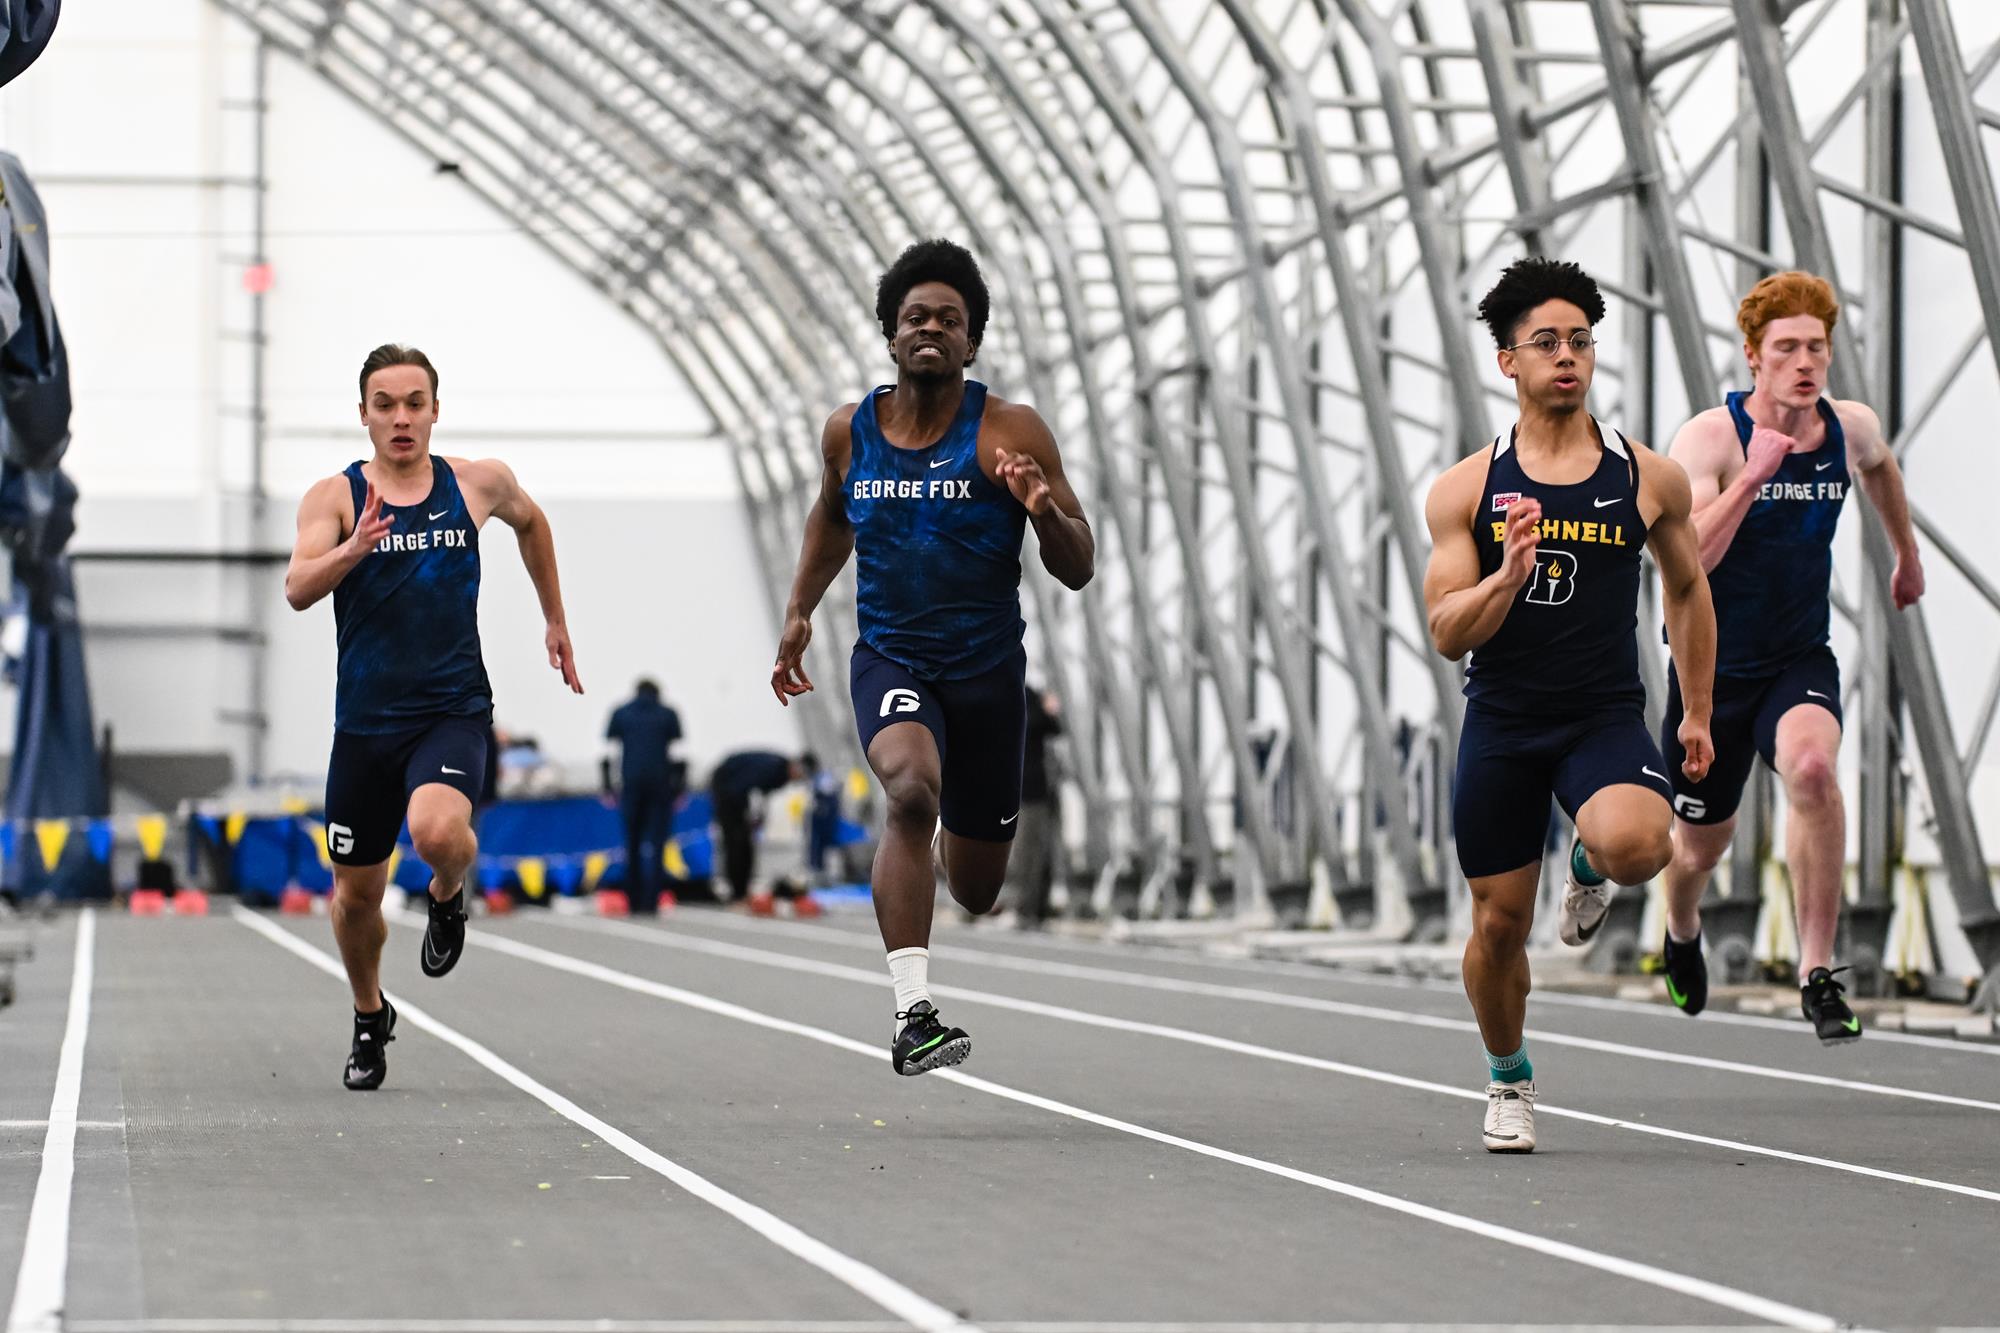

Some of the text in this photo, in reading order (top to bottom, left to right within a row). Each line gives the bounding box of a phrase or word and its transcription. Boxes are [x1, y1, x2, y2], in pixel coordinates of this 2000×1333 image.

[853, 480, 972, 500] GEORGE FOX
[1754, 482, 1844, 501] EORGE FOX
[432, 529, 467, 548] FOX
[1491, 519, 1626, 546] BSHNELL
[1525, 549, 1578, 605] B
